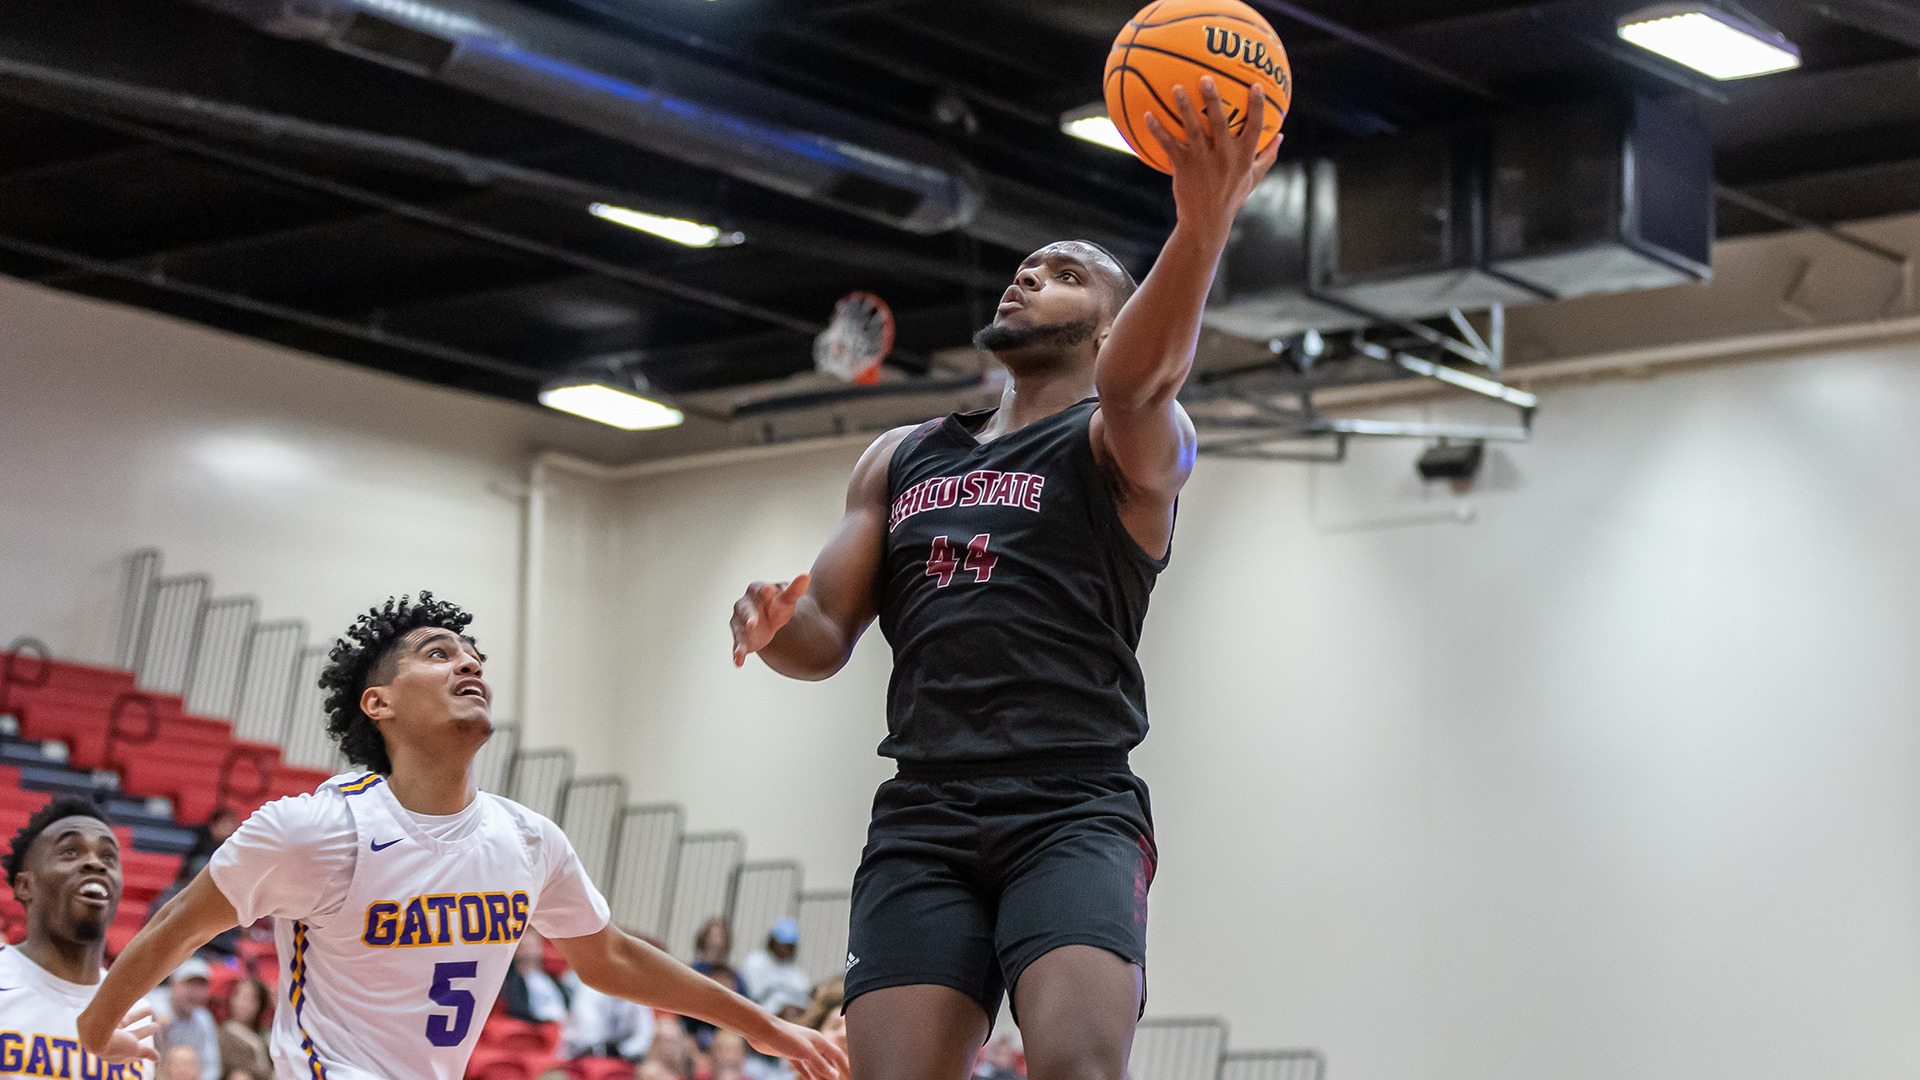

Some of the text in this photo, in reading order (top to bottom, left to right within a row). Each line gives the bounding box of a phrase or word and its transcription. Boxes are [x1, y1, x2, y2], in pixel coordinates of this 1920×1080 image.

[959, 470, 1045, 512] STATE
[926, 533, 999, 588] 44
[361, 890, 530, 948] GATORS
[425, 961, 478, 1047] 5
